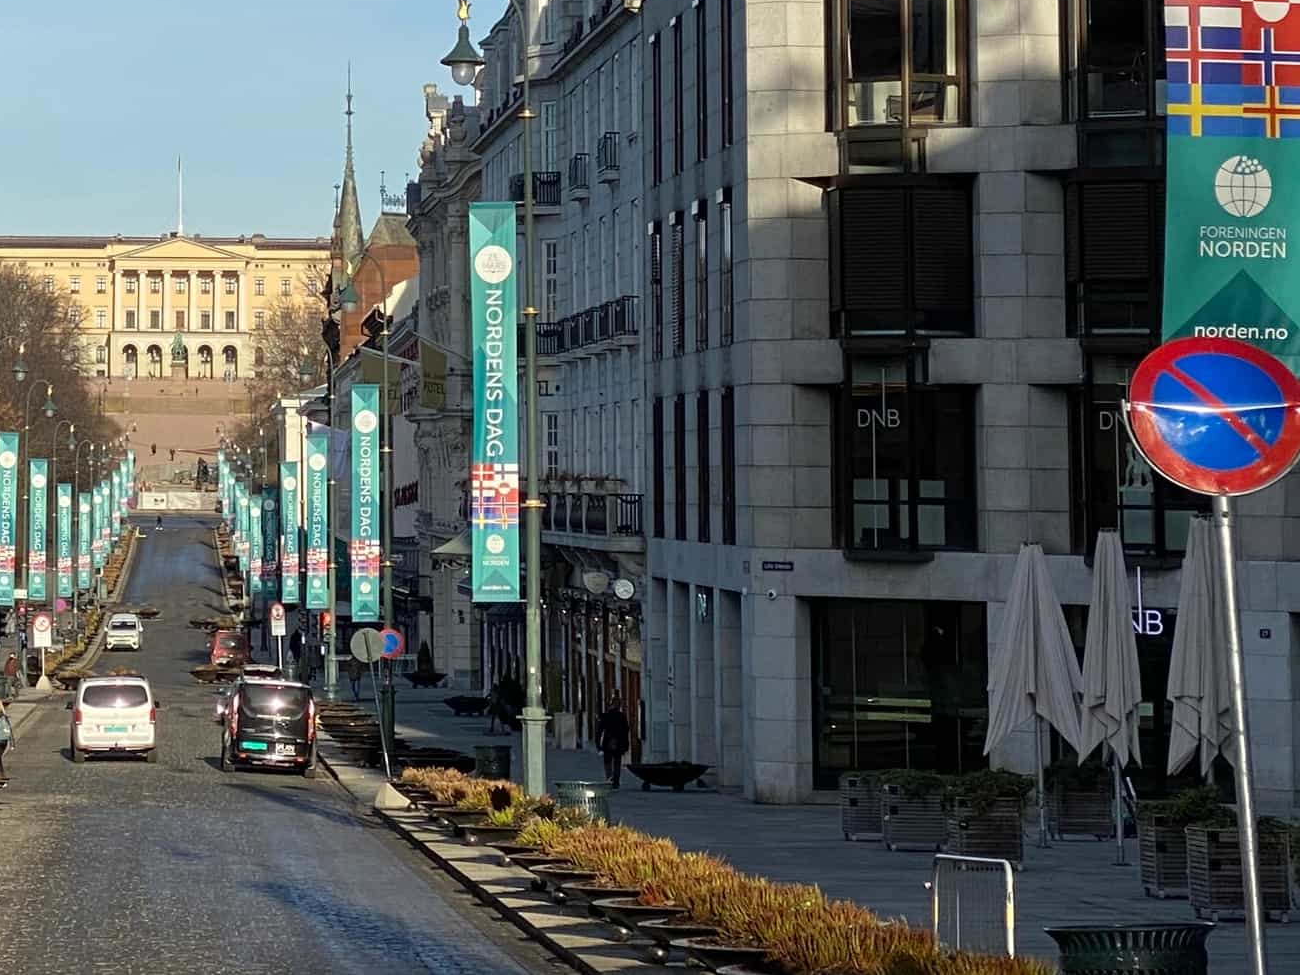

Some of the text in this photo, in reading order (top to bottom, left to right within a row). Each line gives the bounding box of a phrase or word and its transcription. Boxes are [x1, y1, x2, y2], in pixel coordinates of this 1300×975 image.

[1200, 226, 1286, 239] FORENINGEN
[1200, 240, 1286, 258] NORDEN
[1194, 324, 1288, 340] norden.no
[485, 289, 503, 399] NORDENS
[857, 408, 900, 427] DNB
[485, 408, 504, 458] DAG
[360, 436, 372, 537] NORDENS DAG
